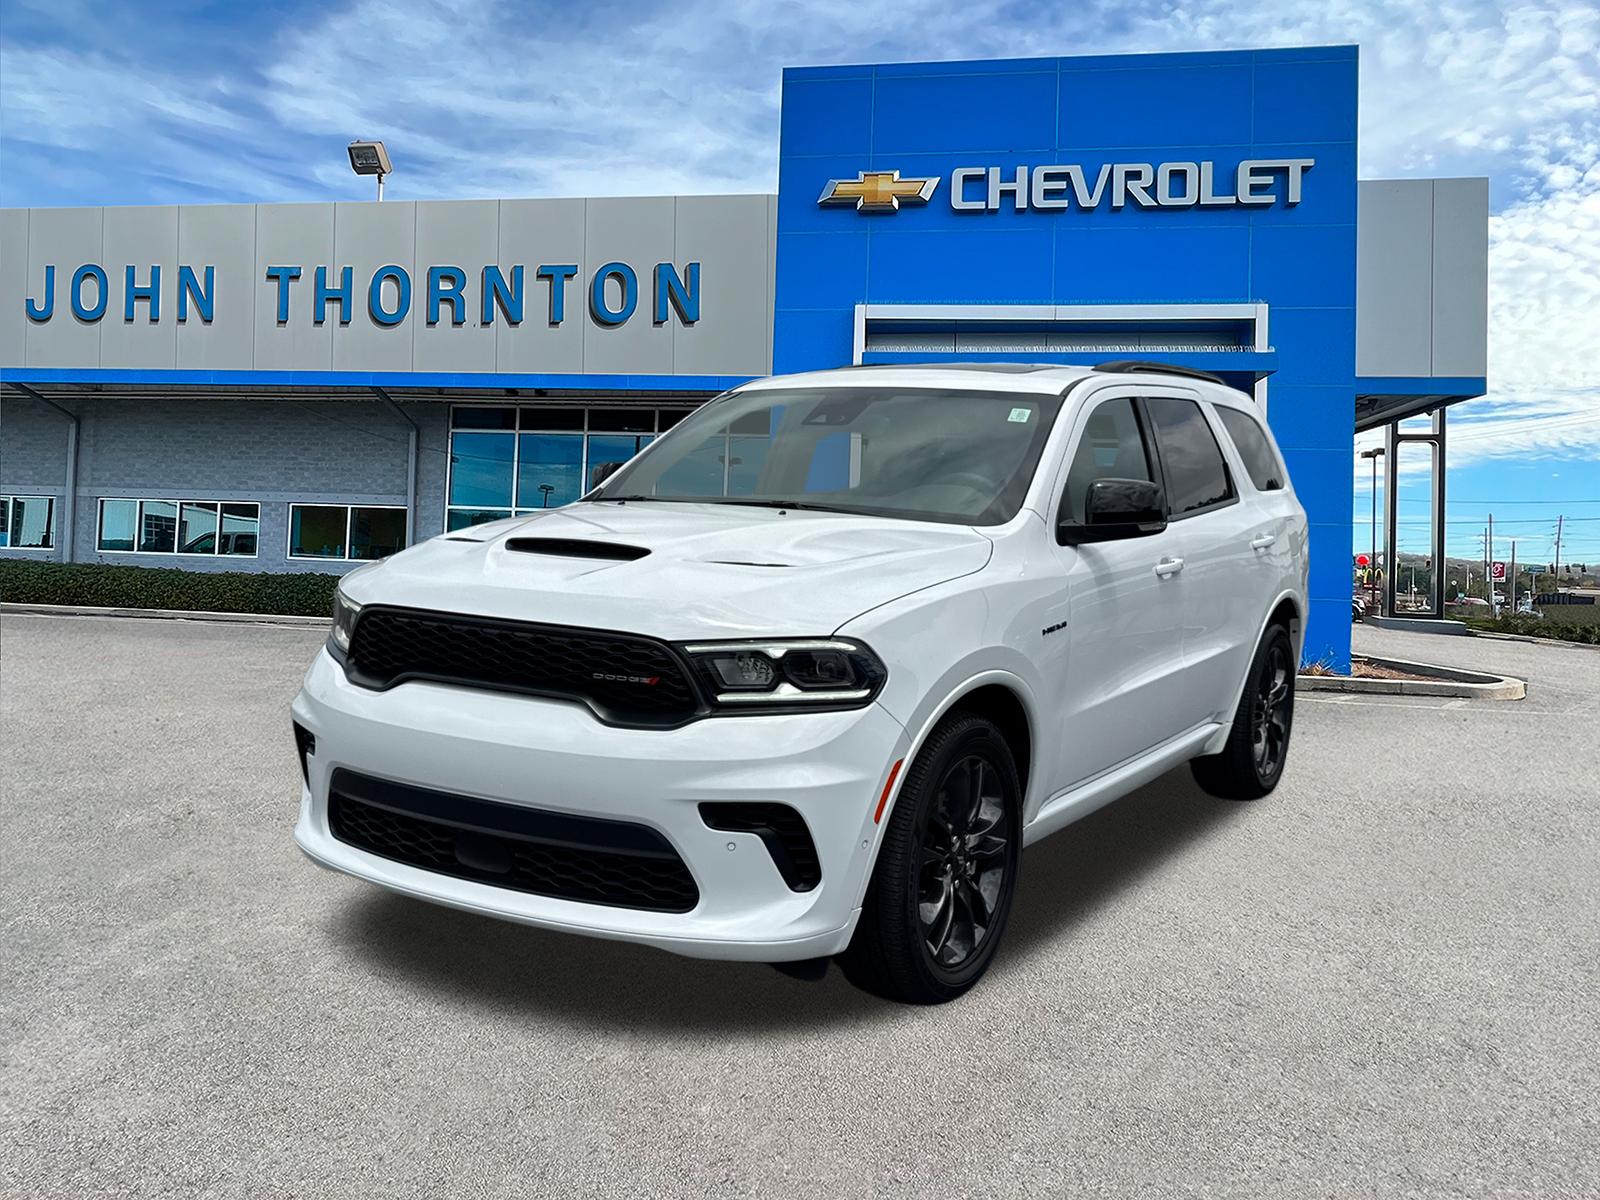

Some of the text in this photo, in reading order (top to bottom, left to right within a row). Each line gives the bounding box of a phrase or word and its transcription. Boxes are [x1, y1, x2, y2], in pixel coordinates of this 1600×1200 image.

[951, 159, 1315, 211] CHEVROLET
[25, 262, 701, 328] JOHN THORNTON
[592, 672, 651, 683] DODGE
